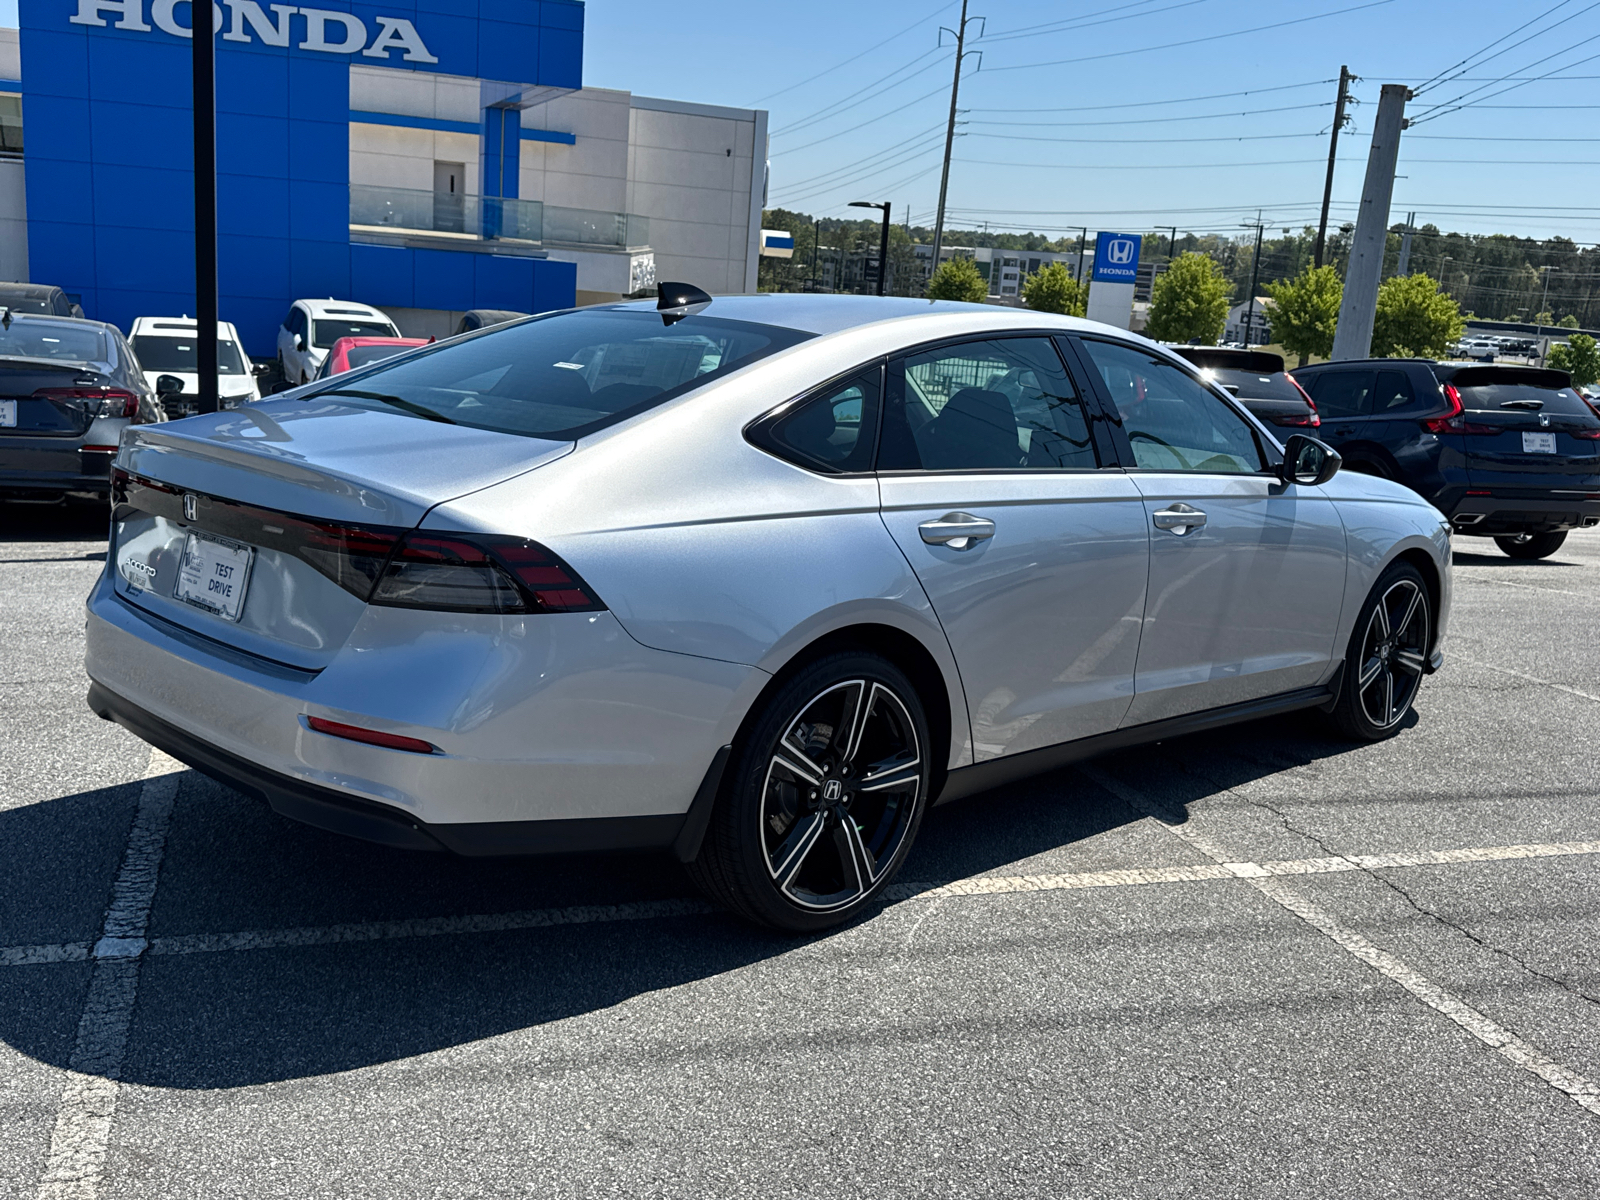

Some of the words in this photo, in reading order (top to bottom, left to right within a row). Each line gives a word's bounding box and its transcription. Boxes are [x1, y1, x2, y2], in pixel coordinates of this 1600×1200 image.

[70, 0, 438, 63] HONDA
[1099, 267, 1135, 276] HONDA
[125, 557, 157, 577] ACCORD
[215, 562, 234, 579] TEST
[208, 578, 232, 598] DRIVE
